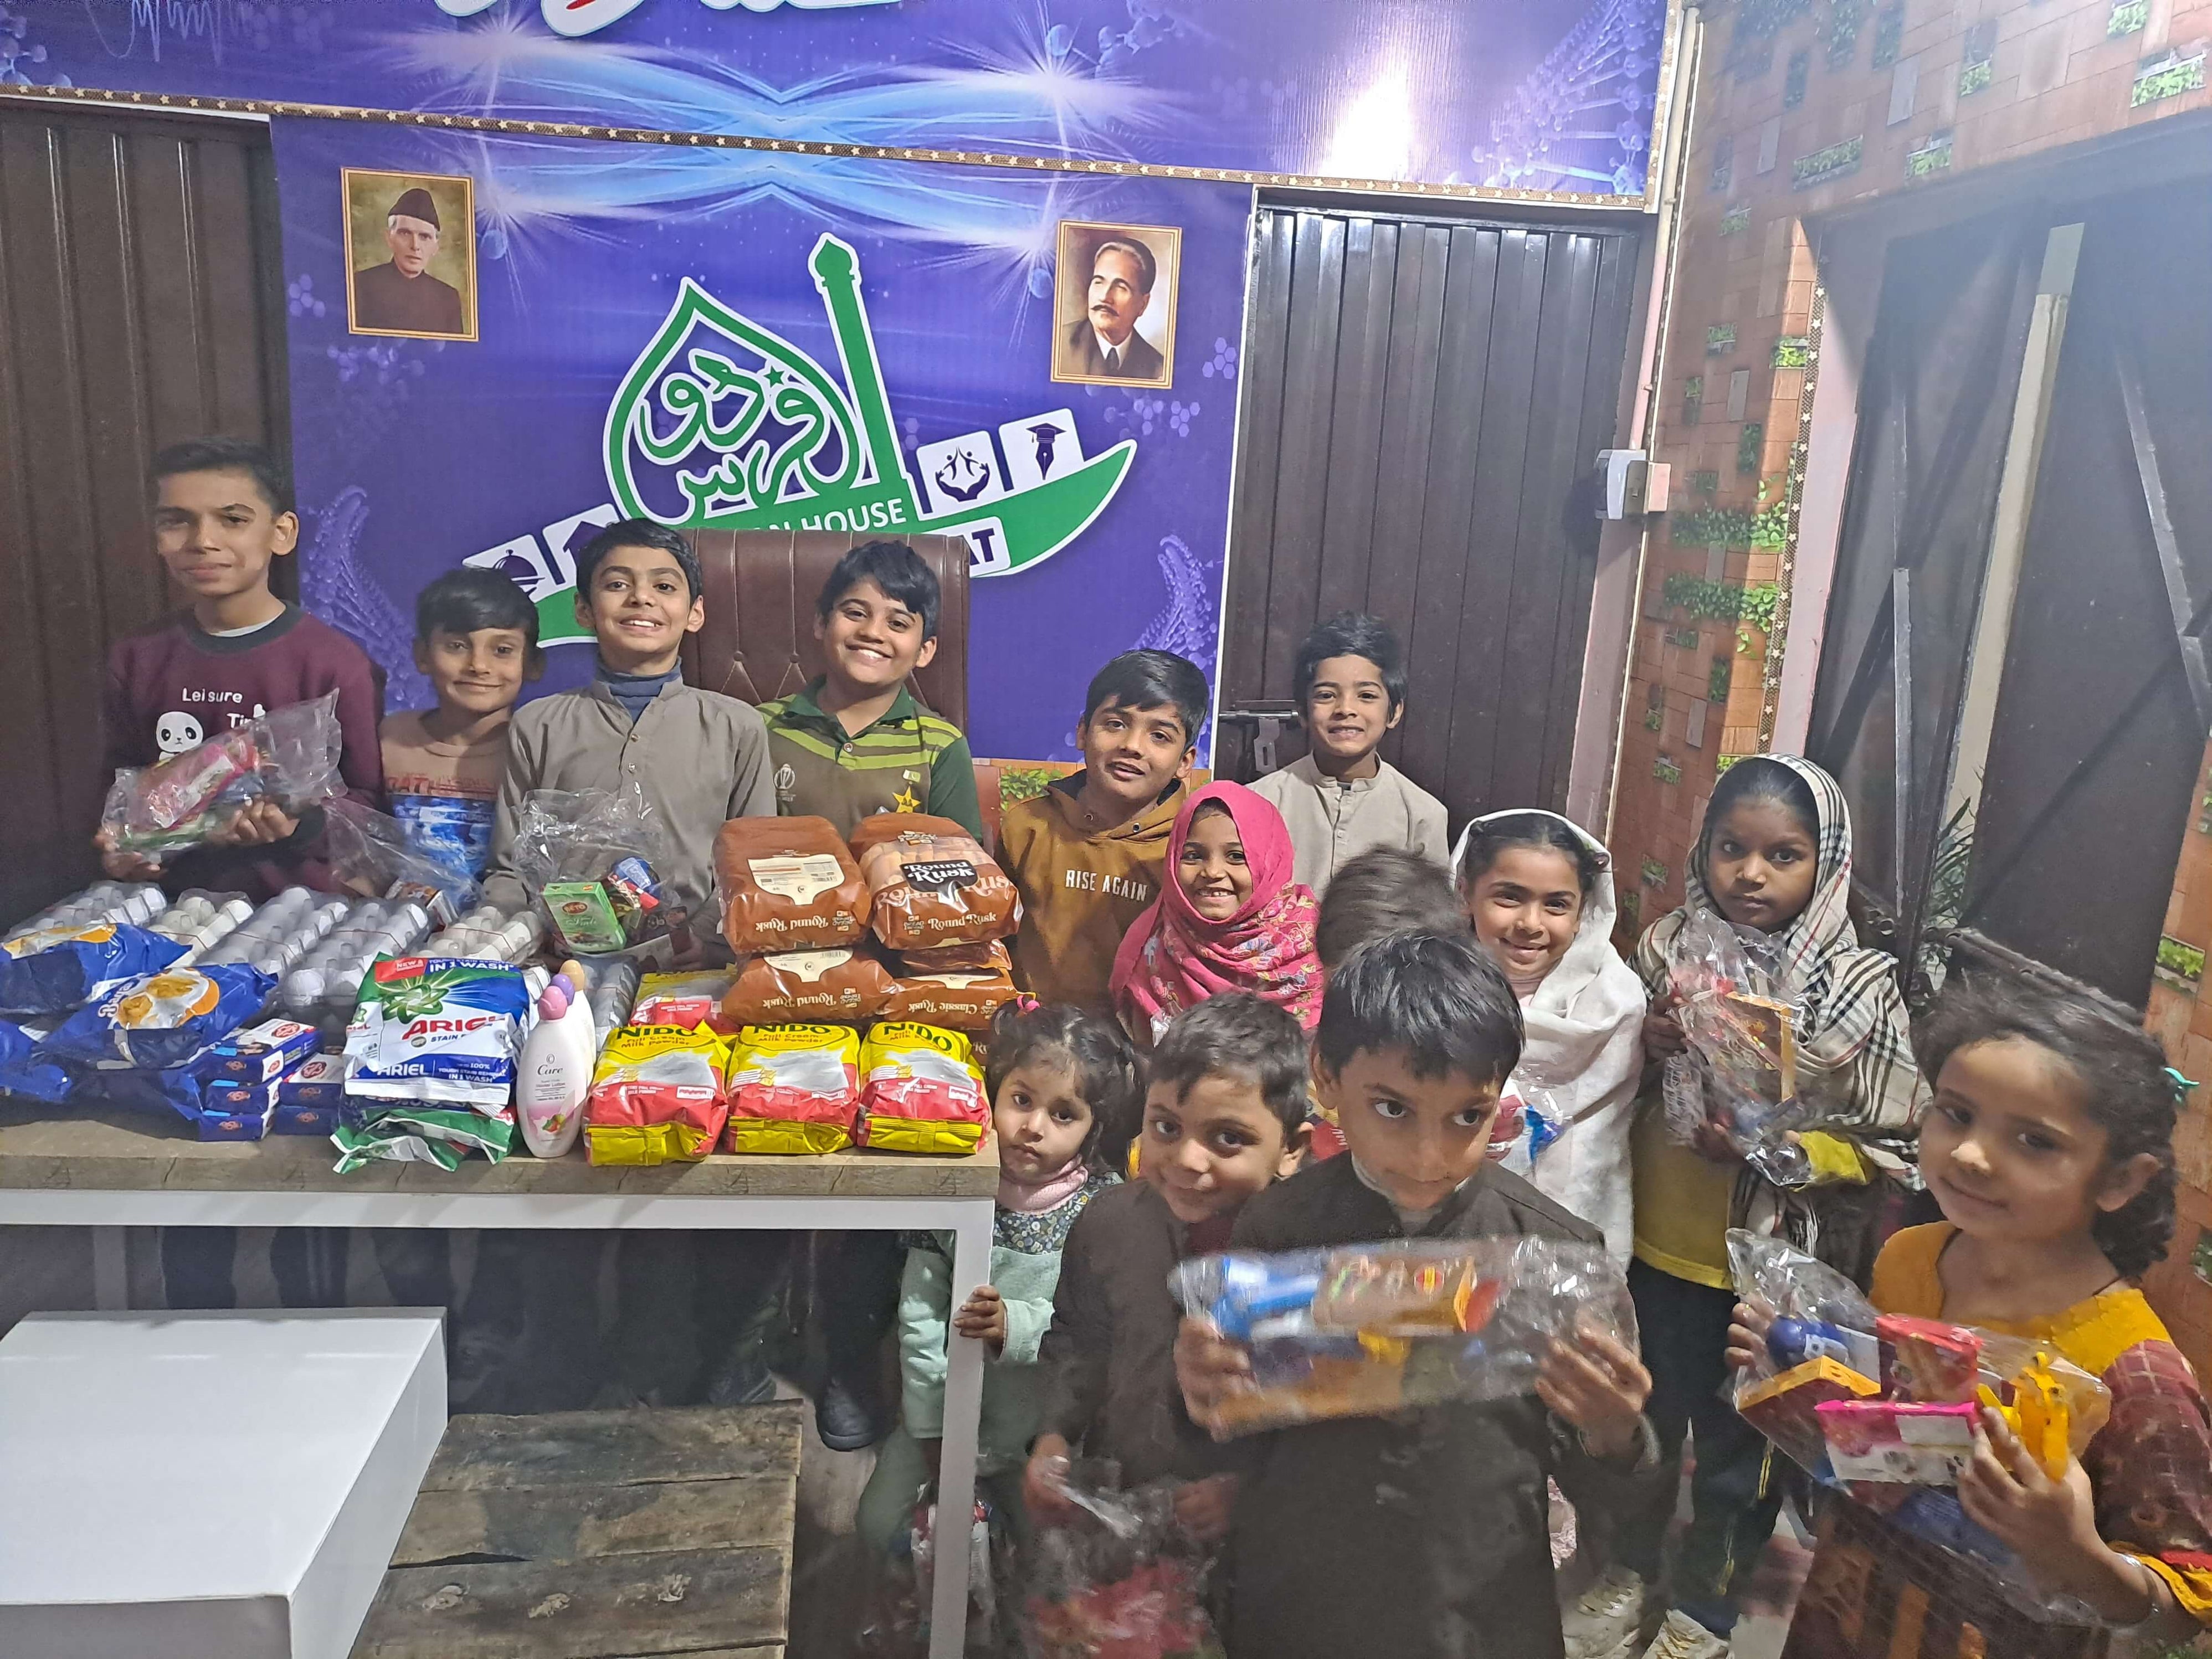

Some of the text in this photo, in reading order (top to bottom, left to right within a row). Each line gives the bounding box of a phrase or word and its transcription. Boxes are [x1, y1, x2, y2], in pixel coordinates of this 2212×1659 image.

[800, 497, 907, 531] HOUSE
[182, 687, 243, 703] Leisure
[904, 861, 968, 872] Round
[907, 868, 974, 884] Rusk
[1065, 869, 1148, 902] RISE AGAIN
[756, 918, 788, 932] Rusk
[790, 915, 829, 930] Round
[928, 916, 966, 931] Round
[966, 912, 996, 925] Rusk
[430, 963, 446, 972] IN
[753, 1024, 831, 1034] NIDO
[884, 1023, 952, 1051] NIDO
[377, 1064, 429, 1076] ARIEL
[537, 1064, 563, 1075] Care
